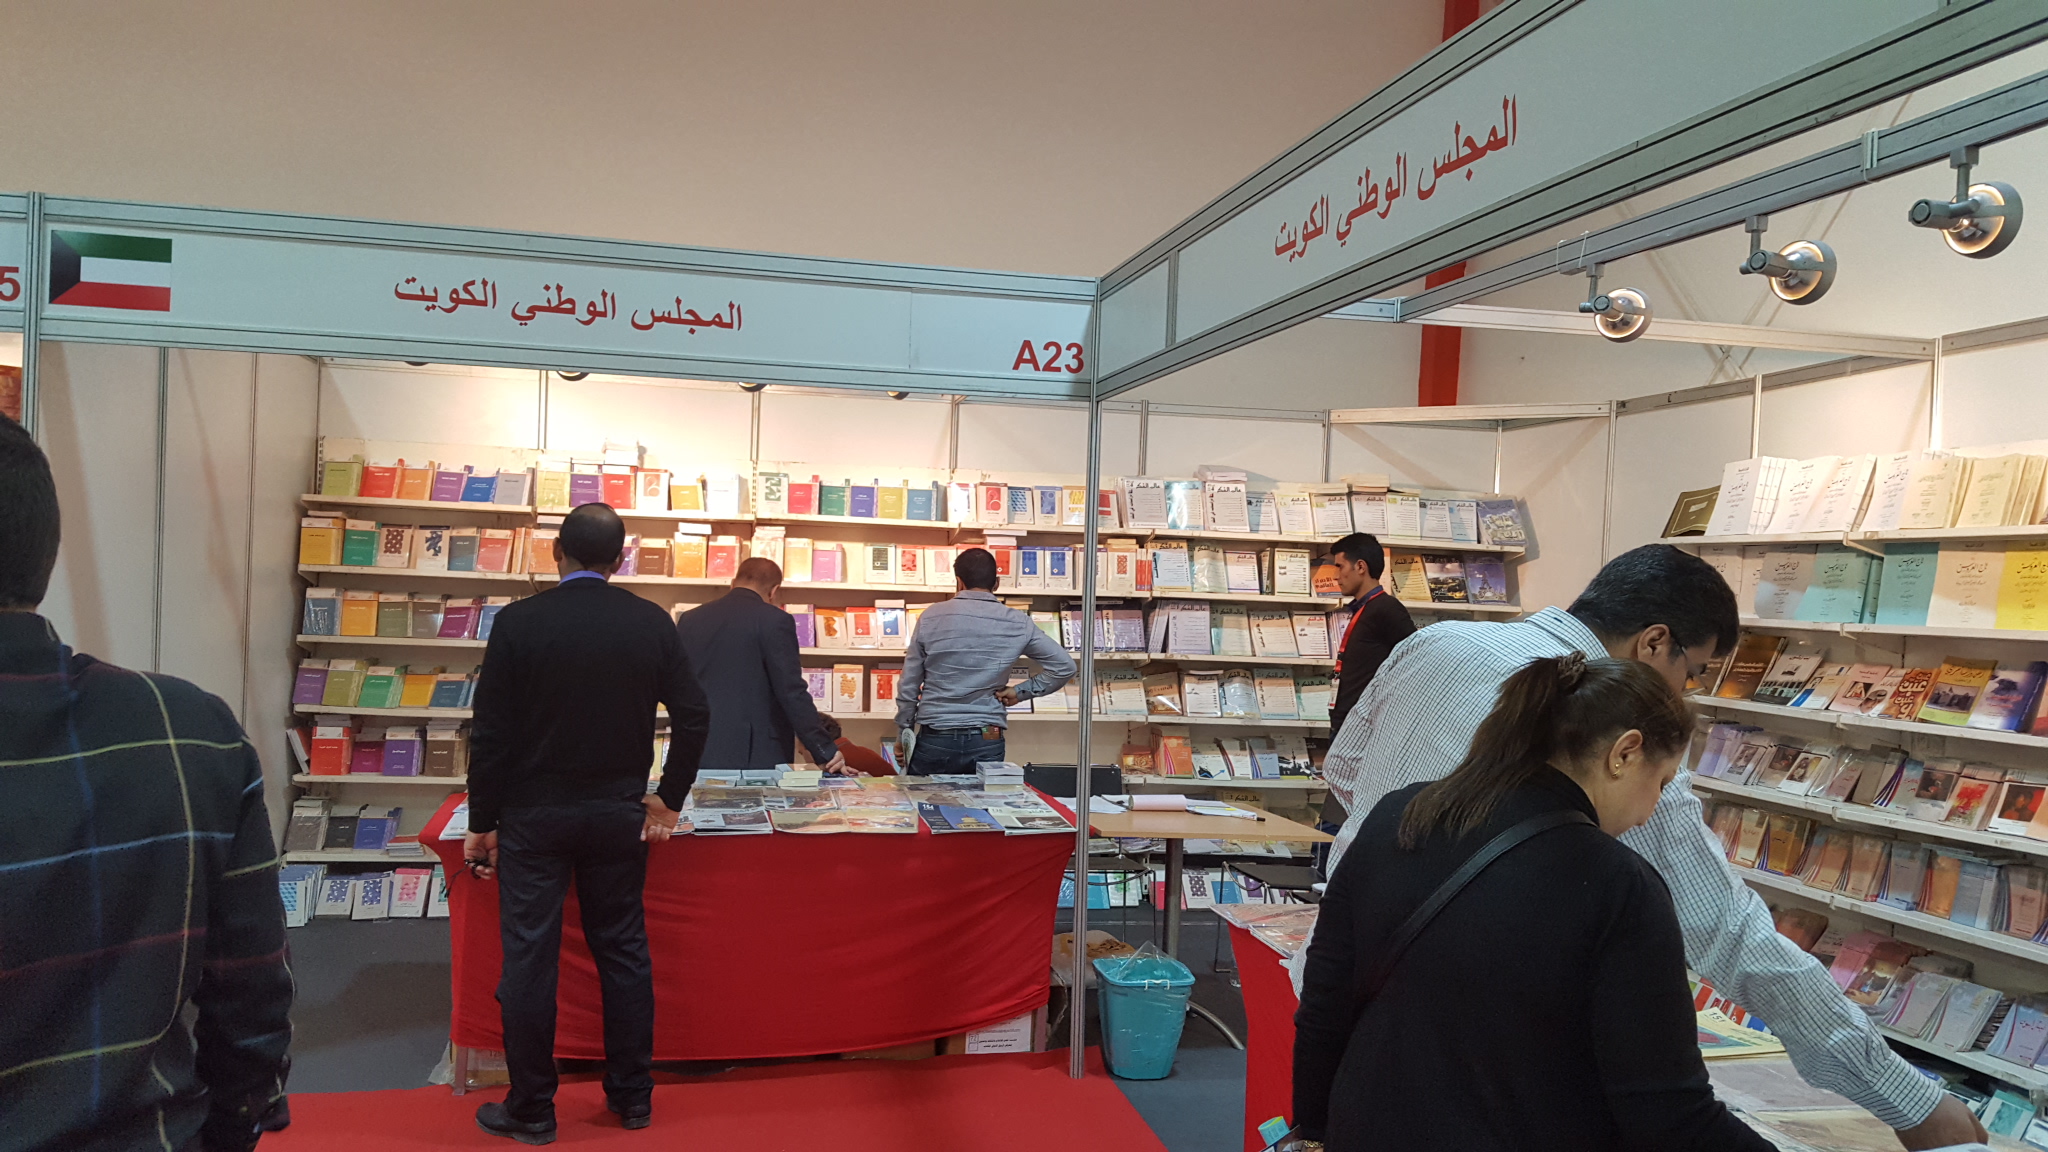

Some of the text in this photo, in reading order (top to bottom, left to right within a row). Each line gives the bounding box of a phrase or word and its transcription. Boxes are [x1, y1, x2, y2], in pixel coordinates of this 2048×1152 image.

[1274, 93, 1517, 263] المجلس الوطني الكويت
[394, 276, 743, 335] المجلس الوطني الكويت
[1012, 339, 1085, 374] A23
